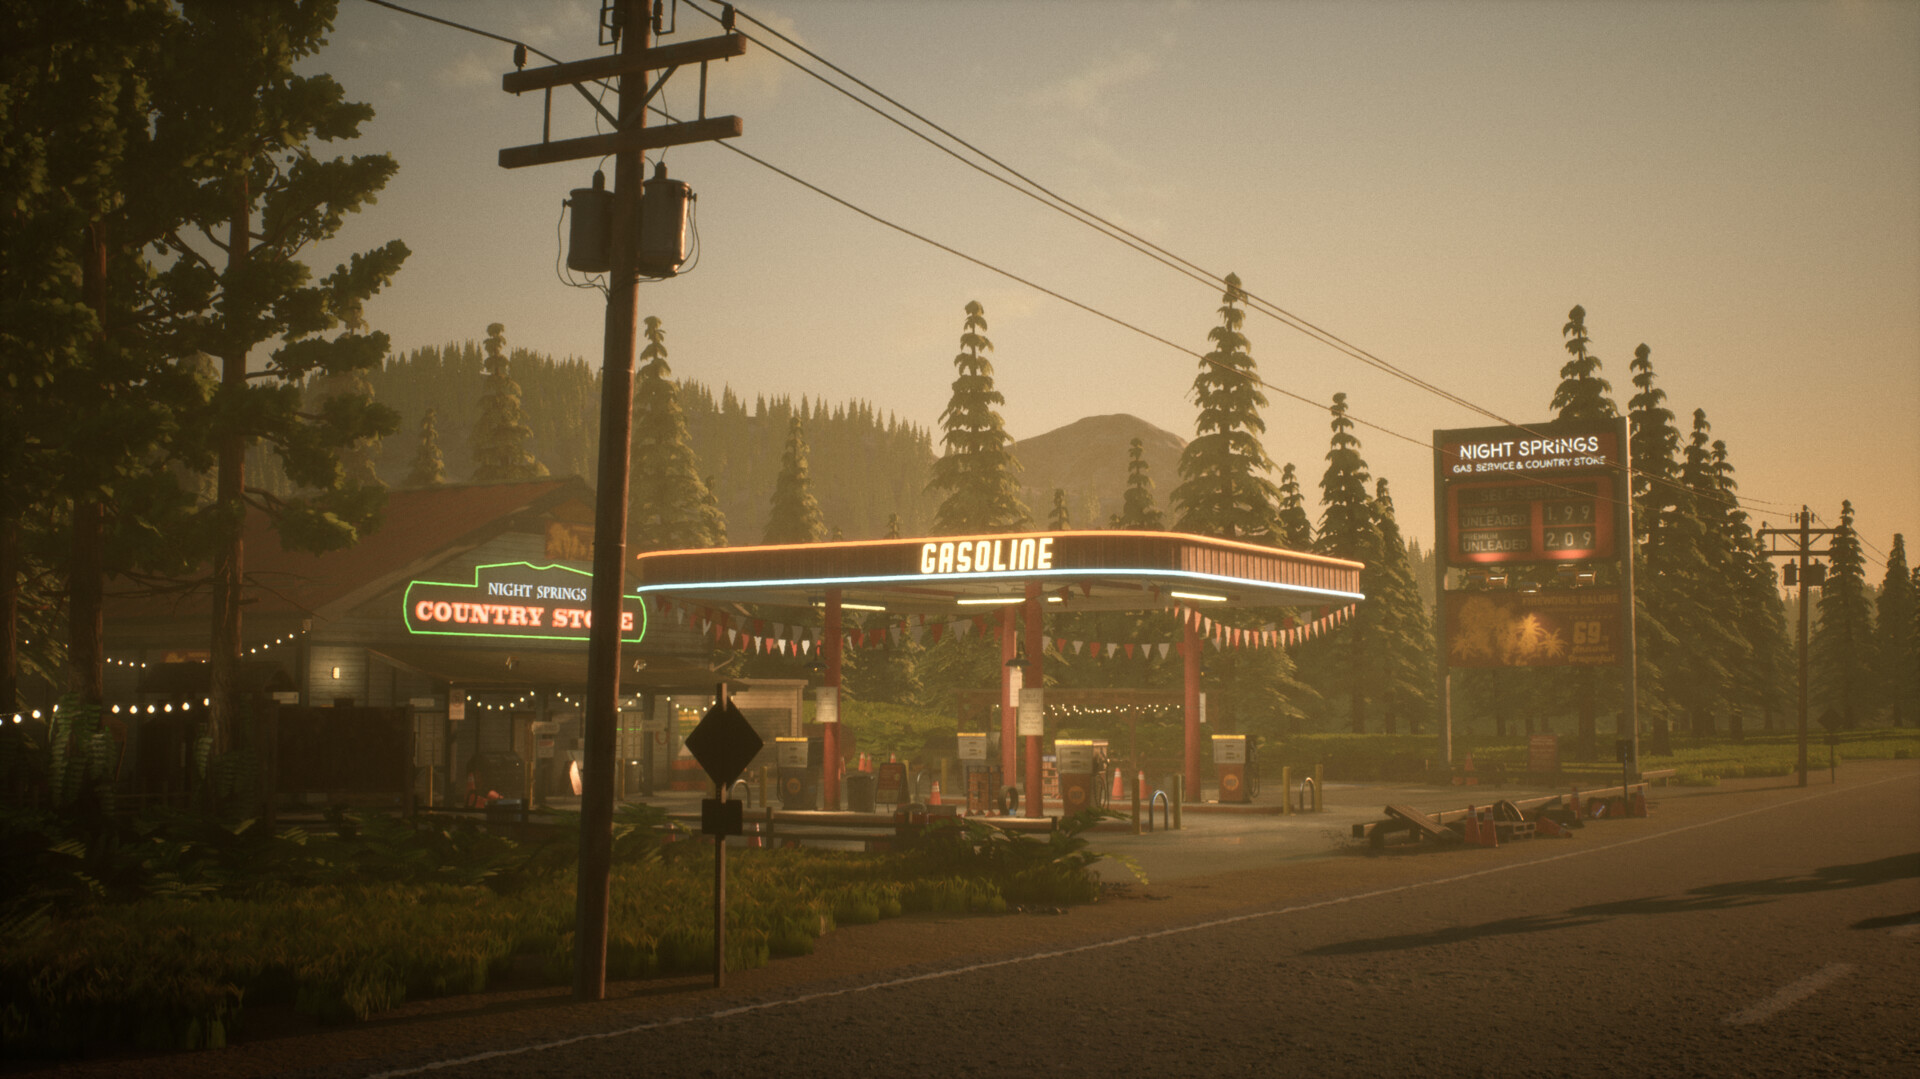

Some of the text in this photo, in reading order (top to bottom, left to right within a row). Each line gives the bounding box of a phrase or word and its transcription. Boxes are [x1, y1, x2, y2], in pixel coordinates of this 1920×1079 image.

[1460, 436, 1599, 460] NIGHT SPRINGS
[1453, 455, 1606, 473] GAS SERVICE & COUNTRY STORE
[1462, 514, 1527, 528] UNLEADED
[1462, 532, 1498, 541] PREMIUM
[1463, 539, 1528, 553] UNLEADED
[921, 537, 1054, 574] GASOLINE
[488, 581, 588, 602] NIGHT SPRINGS
[415, 600, 634, 632] COUNTRY STE
